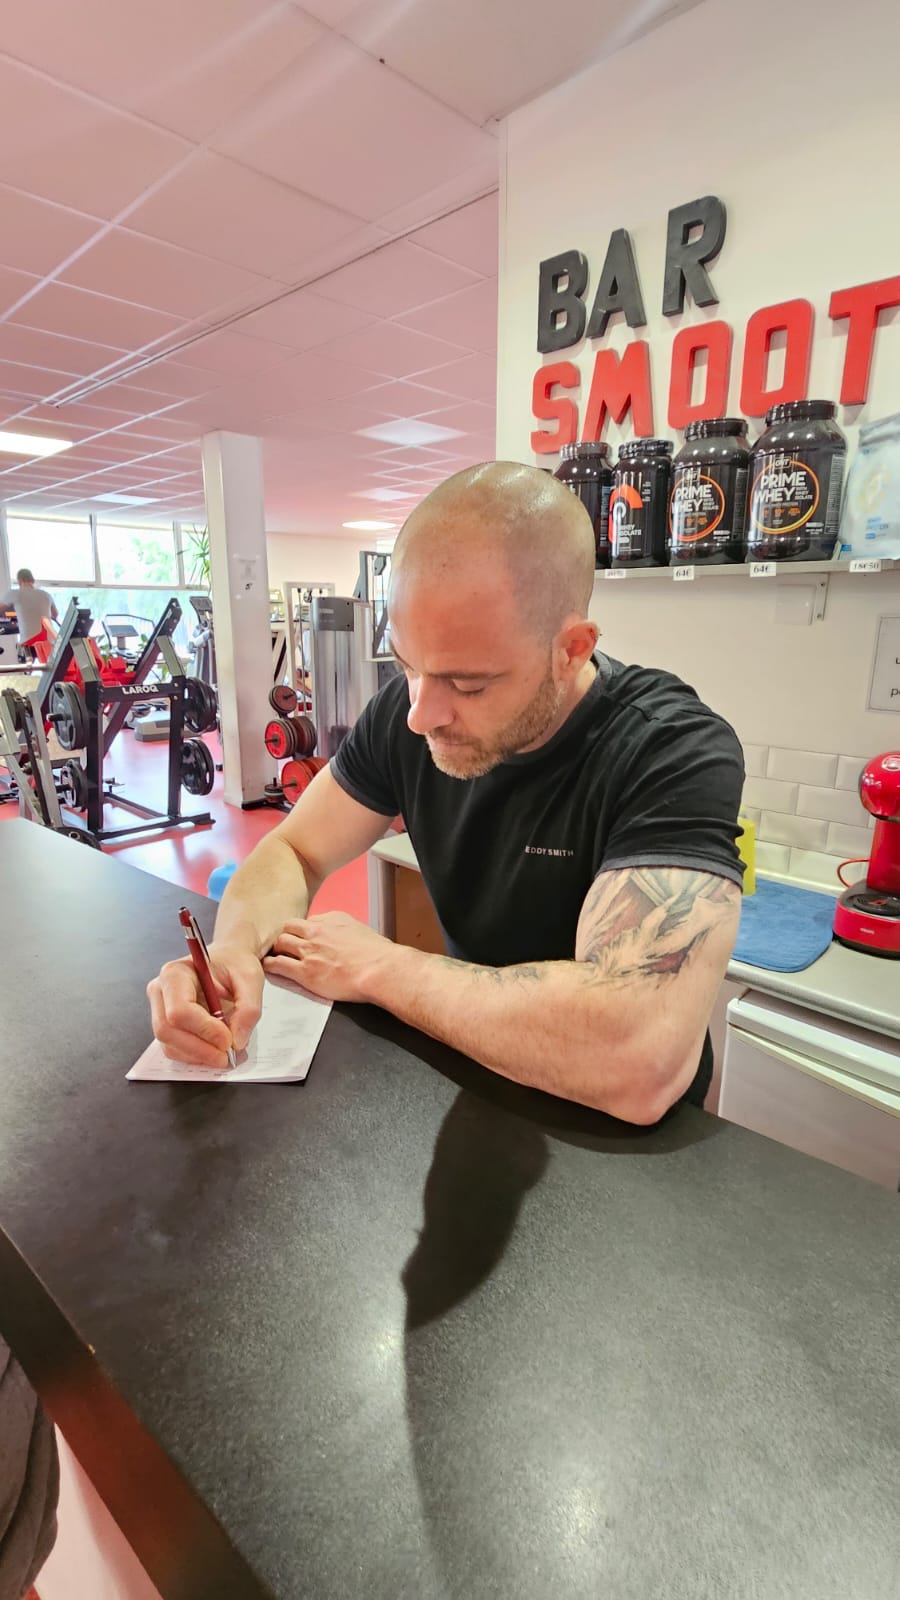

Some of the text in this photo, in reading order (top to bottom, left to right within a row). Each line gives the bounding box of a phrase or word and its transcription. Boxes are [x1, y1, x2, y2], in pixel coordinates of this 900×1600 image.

[537, 195, 727, 354] BAR
[530, 276, 900, 454] SMOOT
[760, 471, 806, 489] PRIME
[675, 484, 712, 500] PRIME
[754, 487, 795, 503] WHEY
[122, 685, 159, 695] LAROQ
